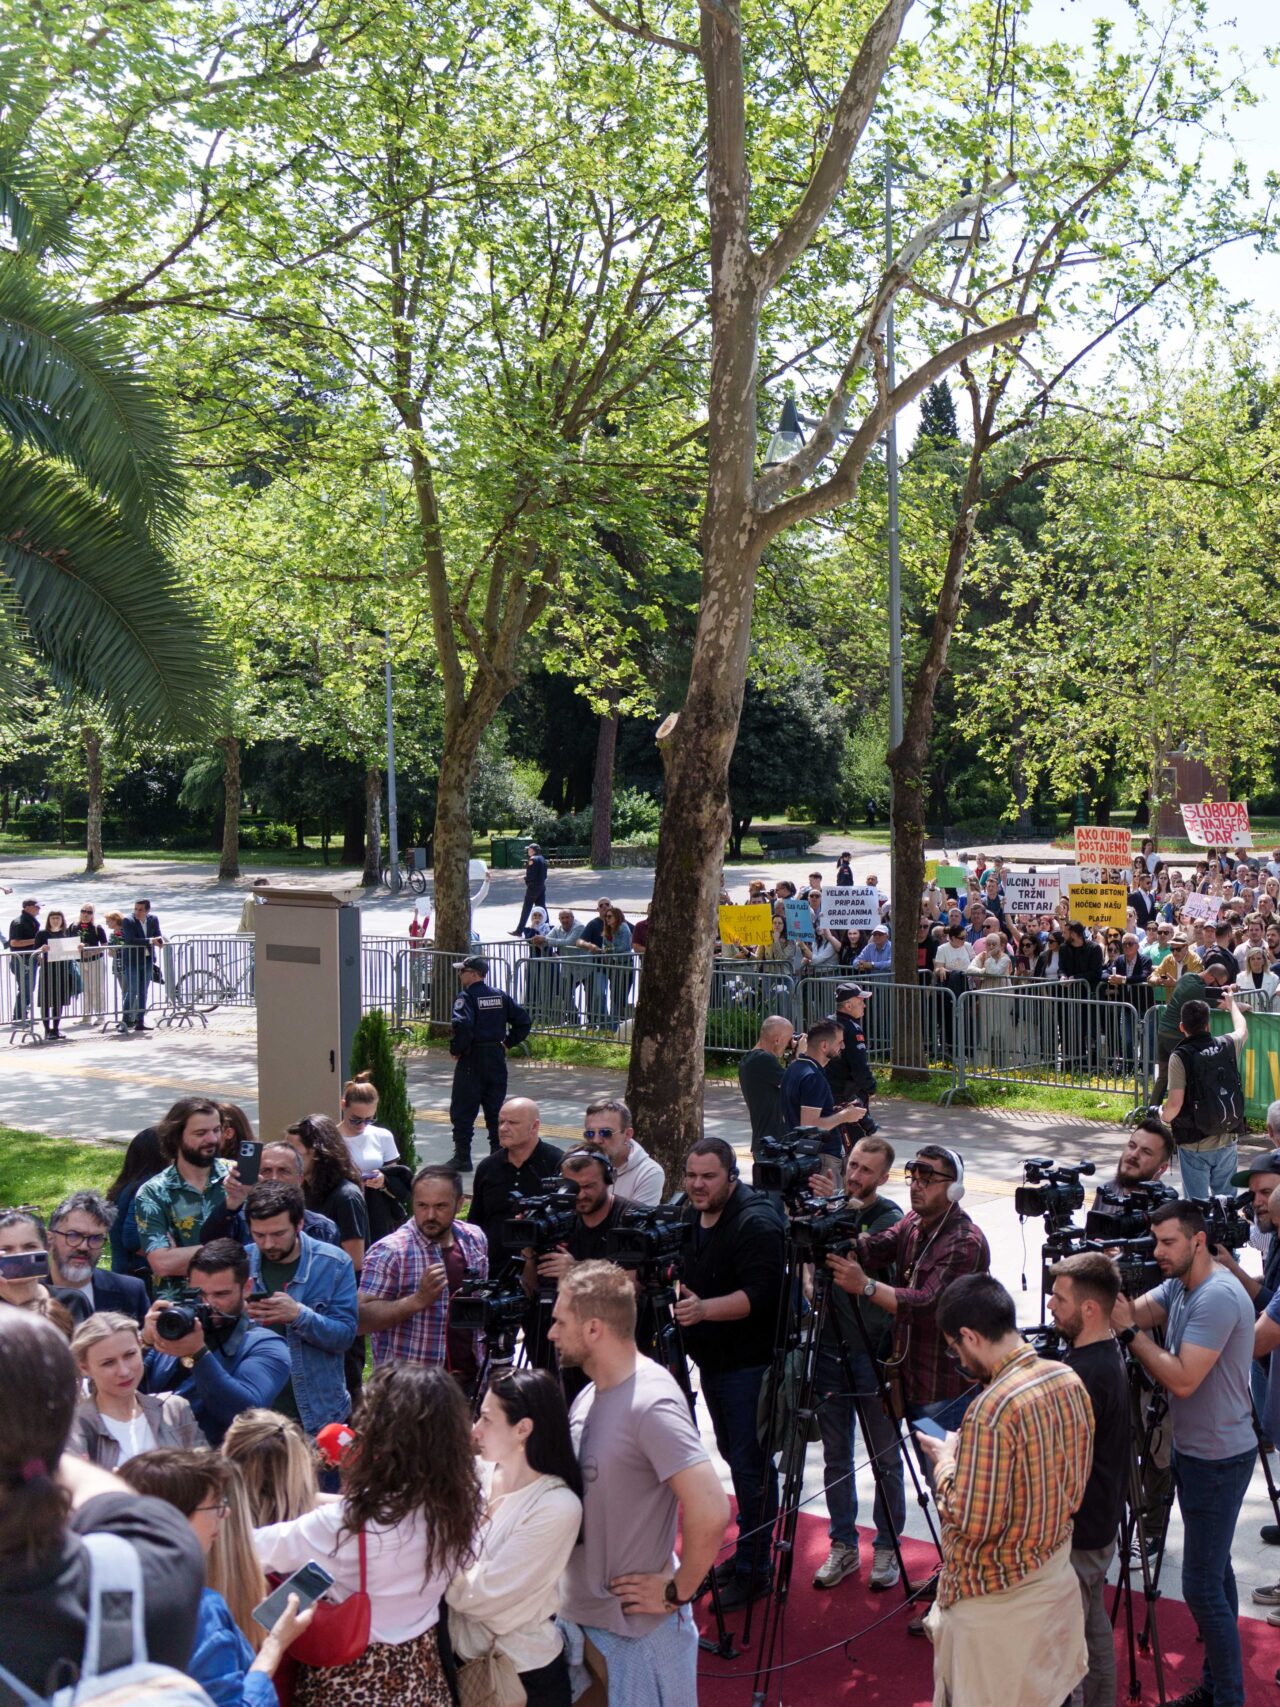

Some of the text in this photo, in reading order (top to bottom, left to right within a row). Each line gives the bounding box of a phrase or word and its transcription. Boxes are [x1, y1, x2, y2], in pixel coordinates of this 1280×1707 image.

[1184, 803, 1247, 819] SLOBODA
[1185, 820, 1199, 831] JE
[1077, 829, 1098, 840] AKO
[1204, 830, 1233, 844] DAR
[1078, 841, 1128, 854] POSTAJEMO
[1080, 853, 1096, 863] DIO
[1006, 878, 1059, 887] ULCINJ NIJE
[826, 887, 874, 897] VELIKA PLAŽA
[1018, 887, 1046, 899] TRŽNI
[835, 899, 866, 907] PRIPADA
[1104, 901, 1122, 910] NAŠU
[829, 918, 849, 926] CRNE
